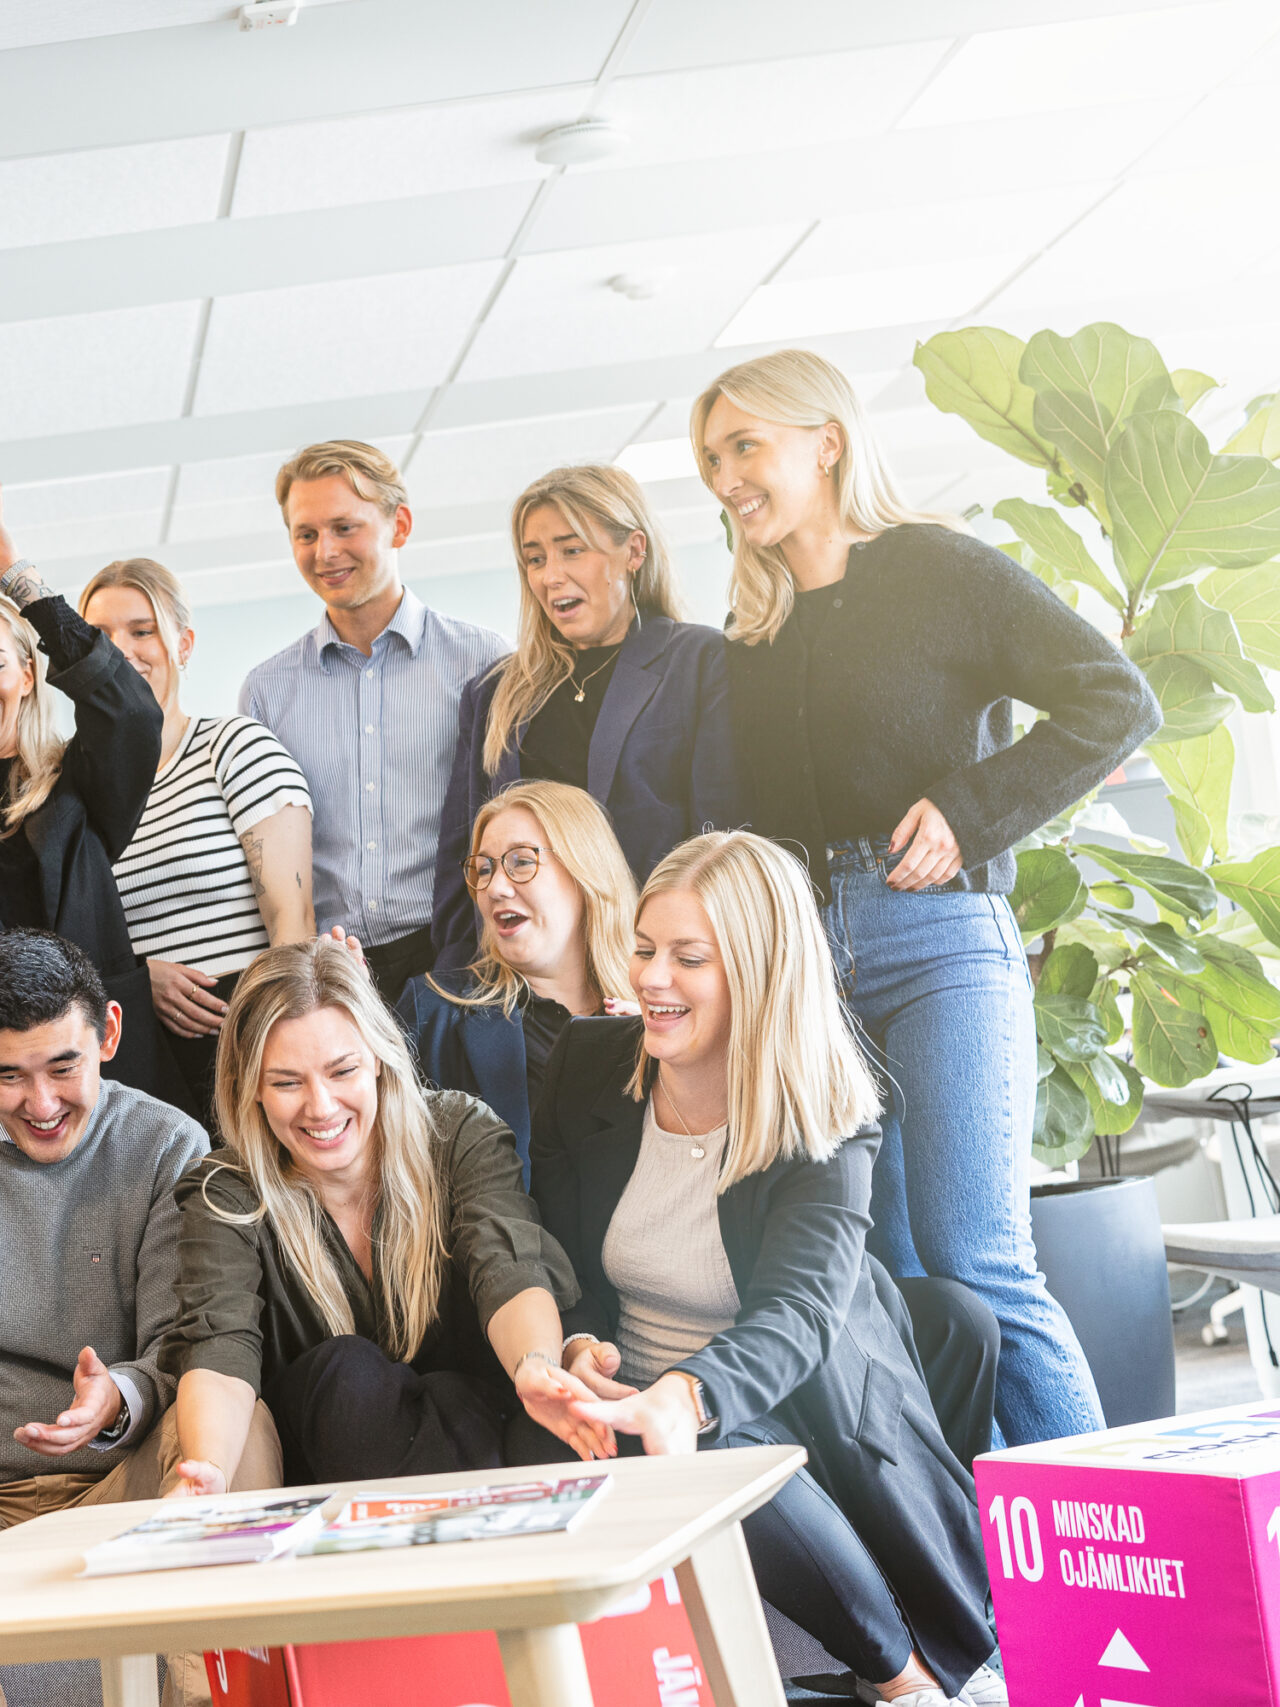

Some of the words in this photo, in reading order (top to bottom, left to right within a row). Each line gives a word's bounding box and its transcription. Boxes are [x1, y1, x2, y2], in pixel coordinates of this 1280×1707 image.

[988, 1495, 1045, 1582] 10
[1051, 1499, 1146, 1544] MINSKAD
[1058, 1545, 1186, 1598] OJÄMLIKHET
